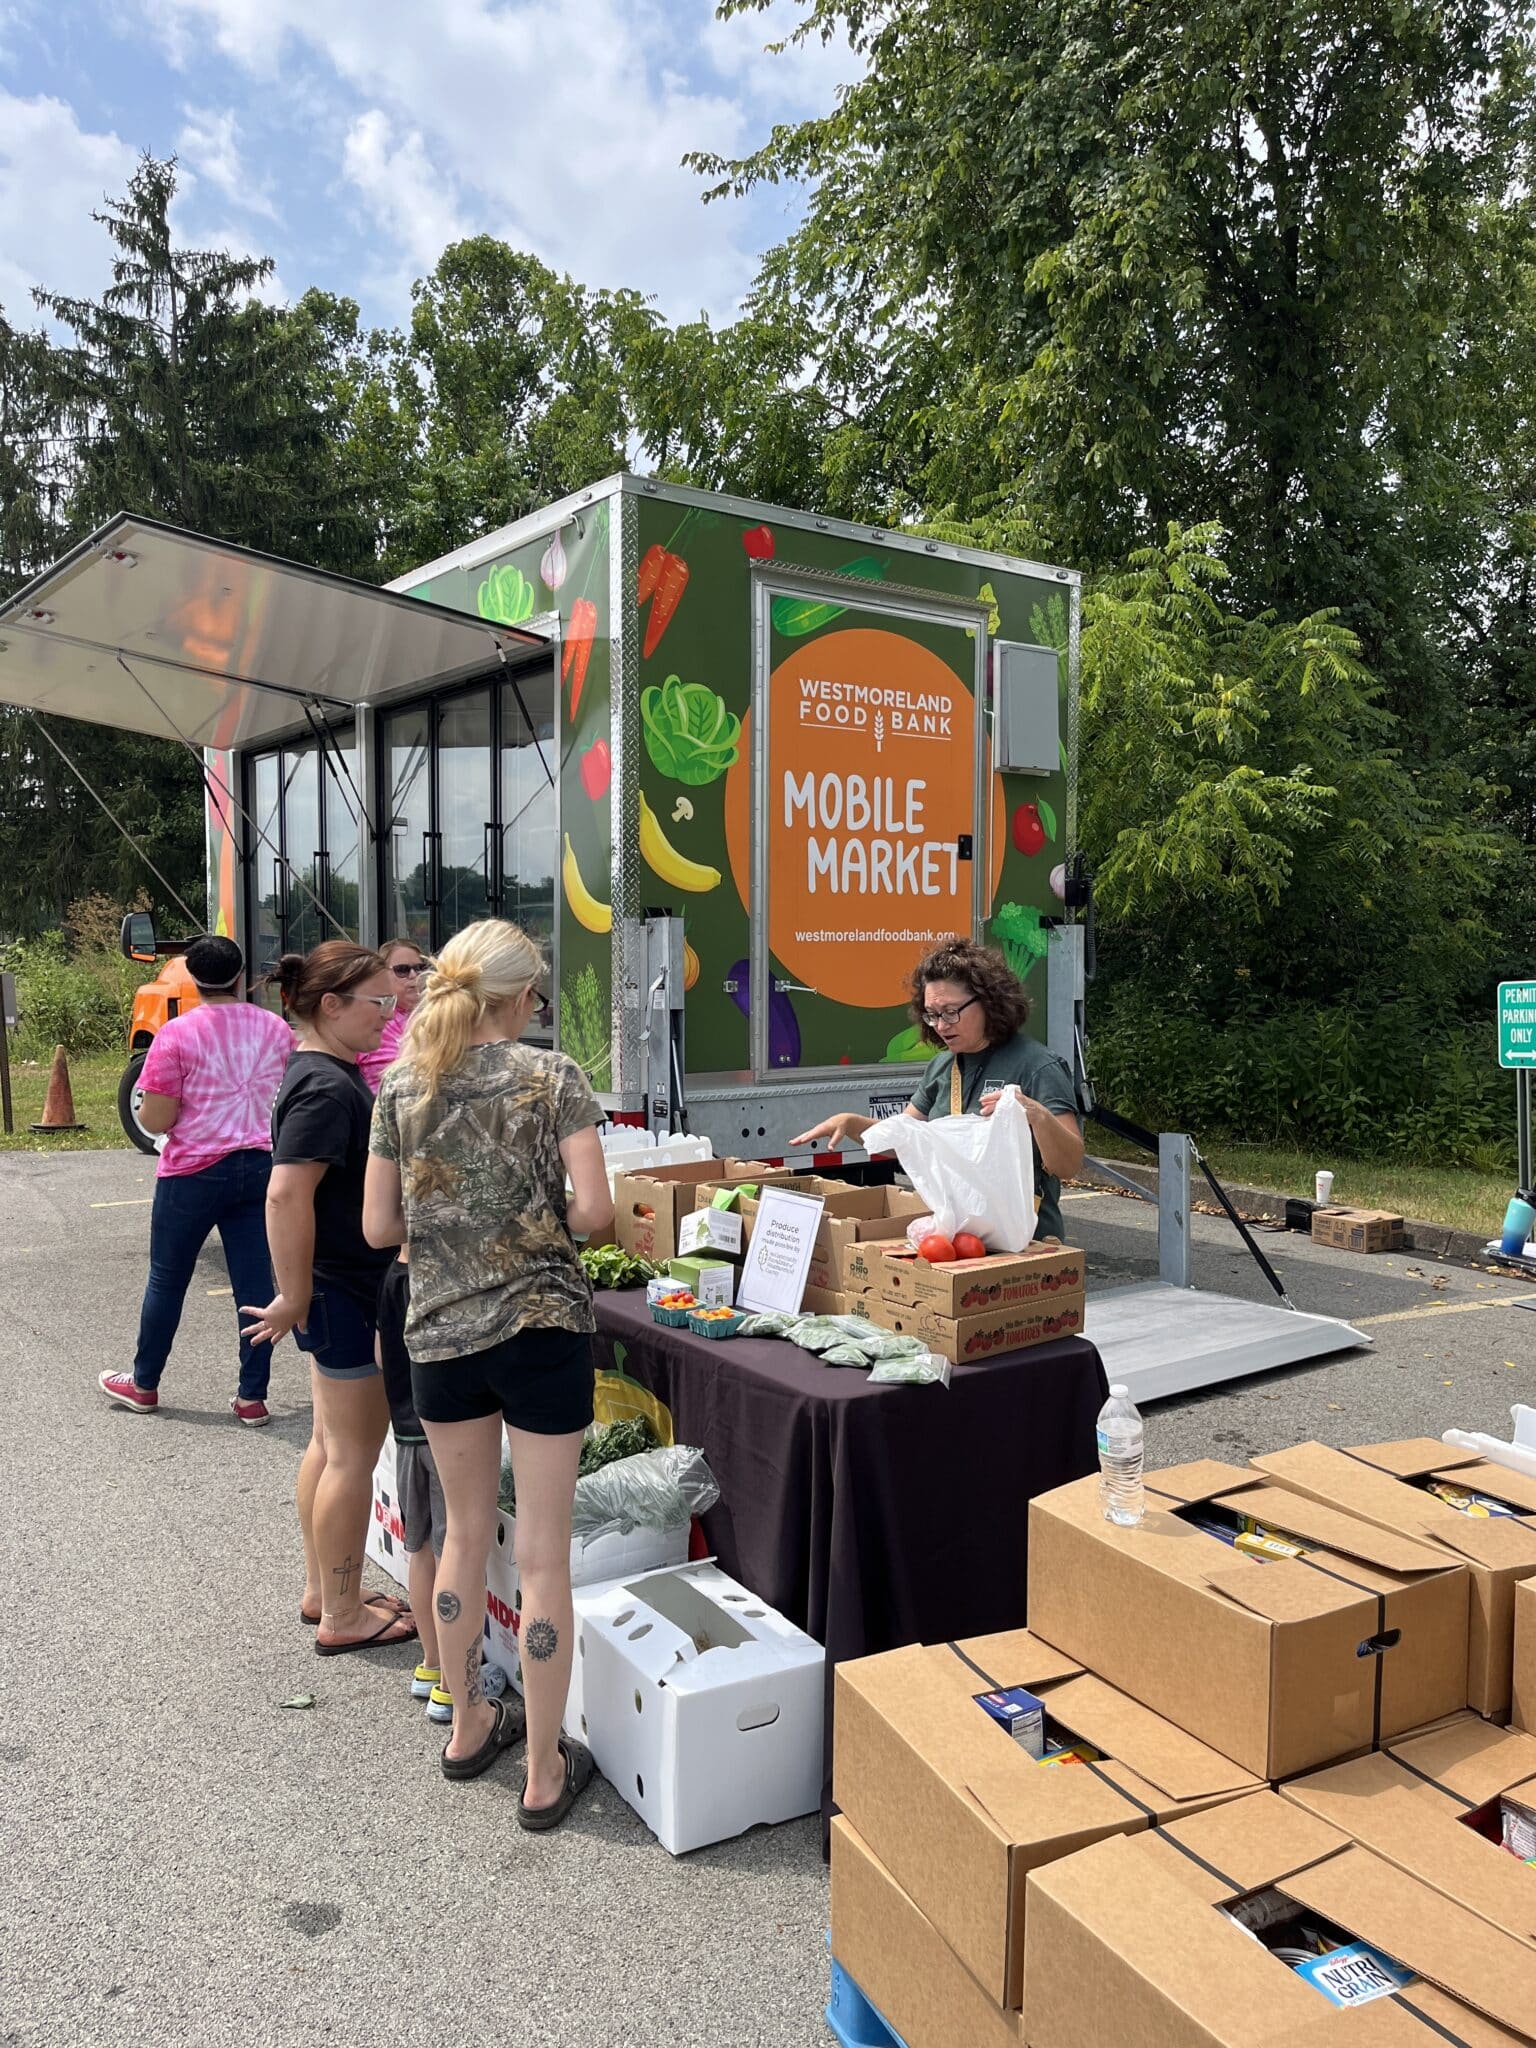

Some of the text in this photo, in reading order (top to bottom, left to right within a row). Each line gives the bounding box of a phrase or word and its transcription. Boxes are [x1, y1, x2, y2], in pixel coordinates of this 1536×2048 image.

[799, 678, 952, 713] WESTMORELAND
[799, 700, 952, 735] FOOD BANK
[784, 770, 927, 834] MOBILE
[807, 836, 959, 896] MARKET
[1505, 988, 1536, 1004] PERMIT
[1502, 1008, 1536, 1025] PARKIN
[1510, 1028, 1533, 1044] ONLY
[766, 1229, 800, 1244] distribution
[771, 1219, 800, 1234] Produce
[849, 1263, 869, 1275] OHIO
[1003, 1283, 1040, 1302] TOMATOES
[850, 1307, 870, 1320] OHIO
[1006, 1324, 1041, 1345] TOMATOES
[486, 1589, 521, 1638] NDY
[1321, 1957, 1378, 1989] NUTRI
[1337, 1971, 1393, 1999] GRAIN
